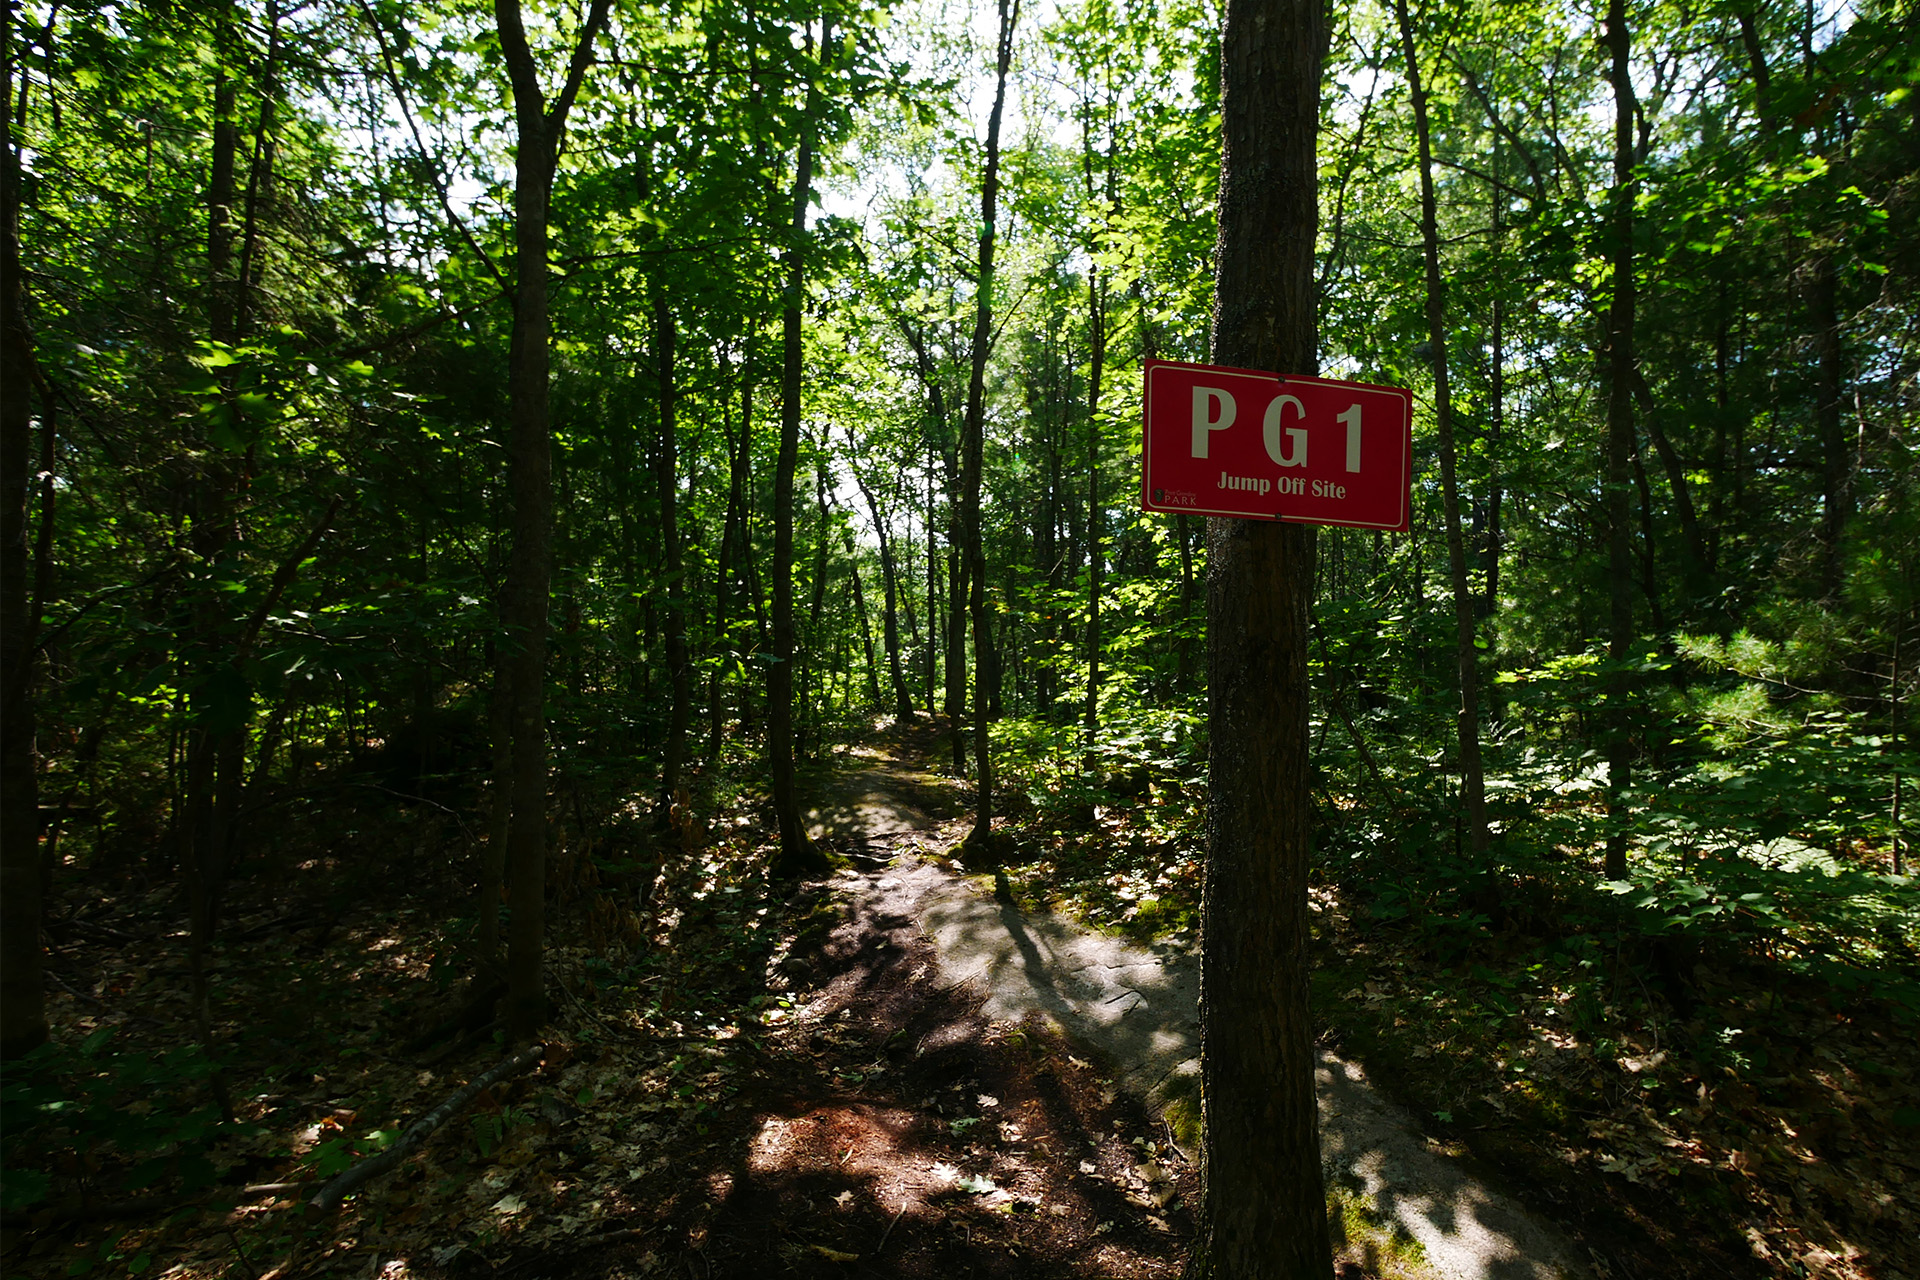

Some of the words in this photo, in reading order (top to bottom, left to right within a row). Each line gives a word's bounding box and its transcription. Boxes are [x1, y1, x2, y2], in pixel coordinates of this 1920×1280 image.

[1192, 385, 1237, 459] P
[1263, 394, 1308, 468] G
[1336, 403, 1362, 473] 1
[1217, 471, 1271, 496] Jump
[1277, 476, 1306, 495] Off
[1311, 478, 1346, 499] Site
[1164, 495, 1197, 506] PARK
